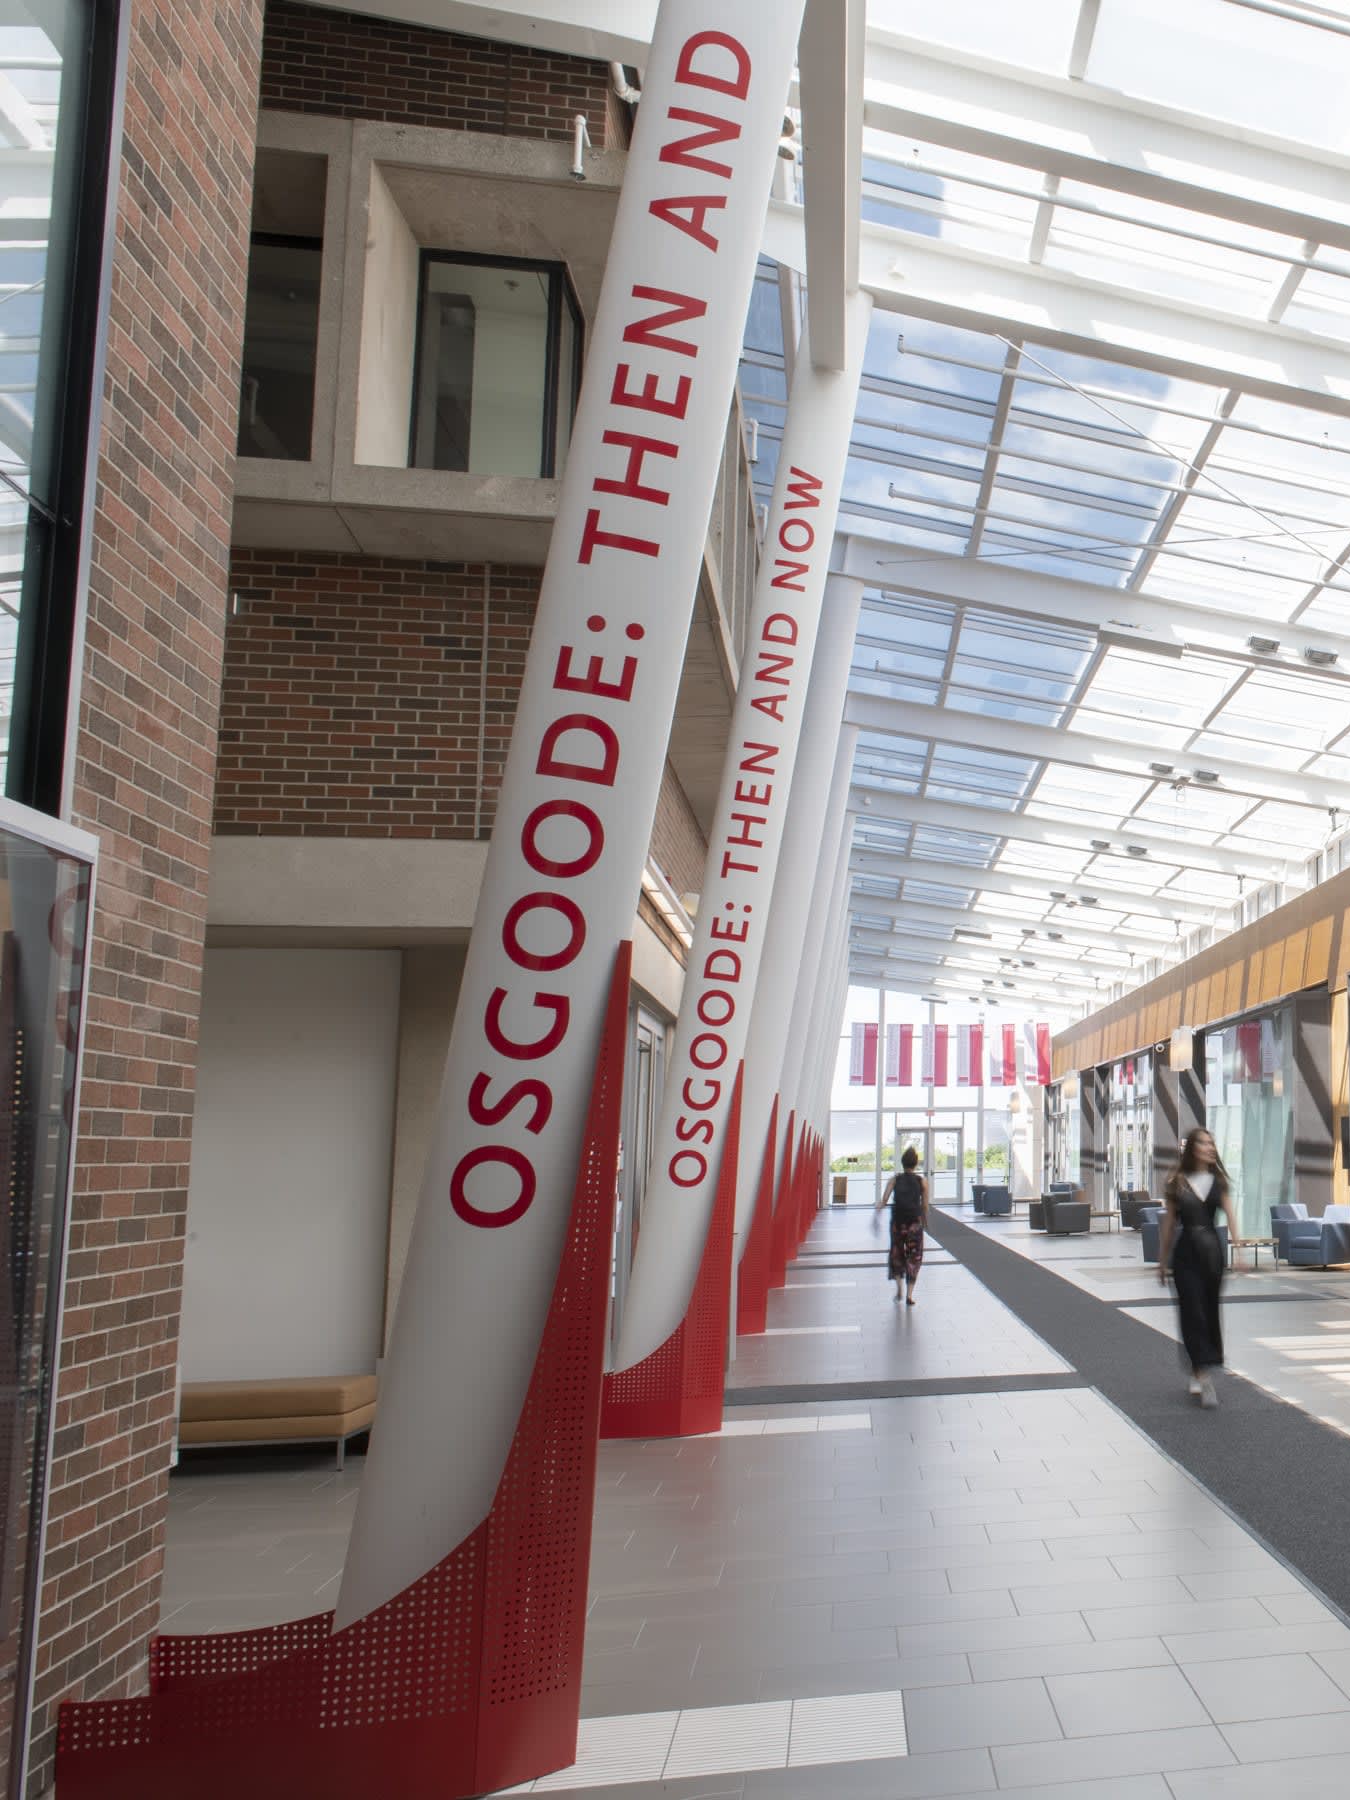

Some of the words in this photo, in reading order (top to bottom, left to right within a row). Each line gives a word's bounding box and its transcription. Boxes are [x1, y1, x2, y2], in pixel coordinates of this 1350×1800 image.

[770, 465, 824, 593] NOW
[450, 614, 645, 1229] OSGOODE:
[577, 284, 708, 565] THEN
[648, 30, 752, 254] AND
[750, 612, 799, 723] AND
[720, 741, 780, 879] THEN
[668, 901, 752, 1188] OSGOODE:
